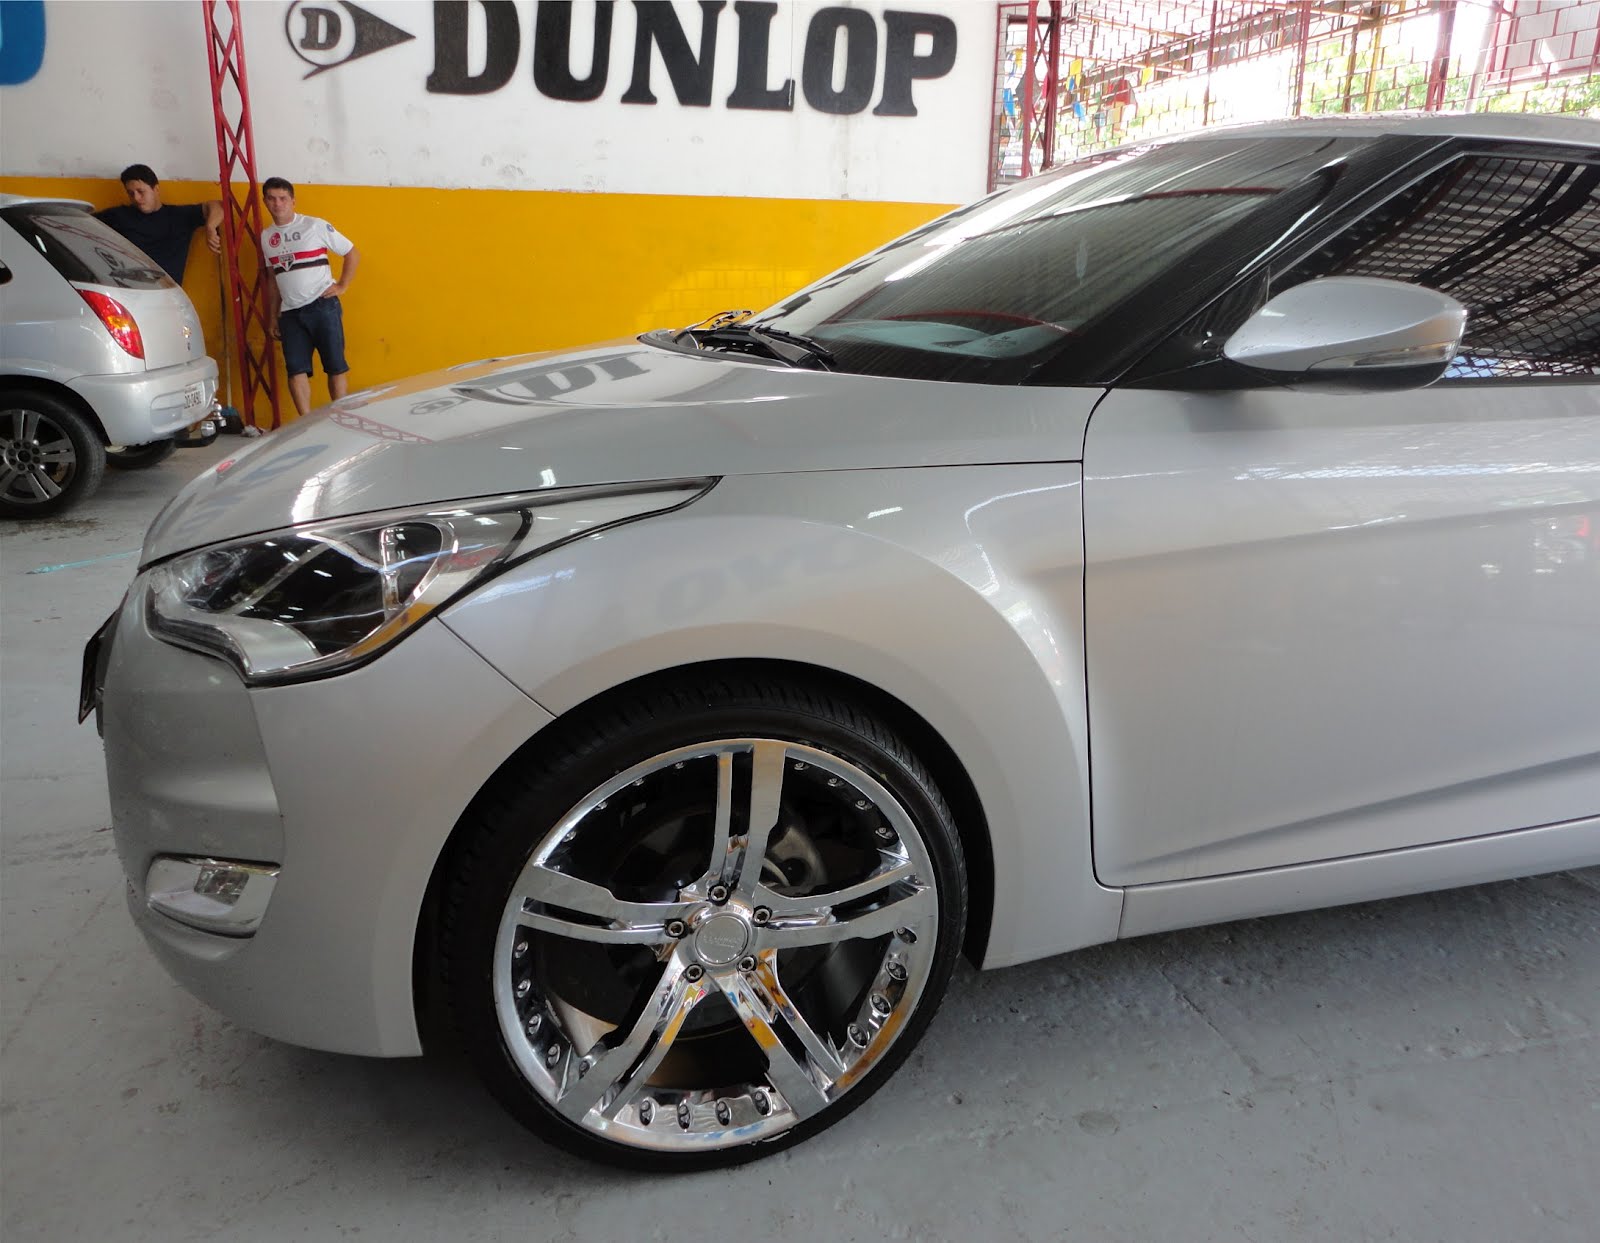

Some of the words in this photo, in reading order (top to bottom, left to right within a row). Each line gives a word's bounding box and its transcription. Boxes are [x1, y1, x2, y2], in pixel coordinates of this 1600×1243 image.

[300, 7, 342, 50] D
[426, 0, 958, 117] DUNLOP
[284, 231, 301, 242] LG
